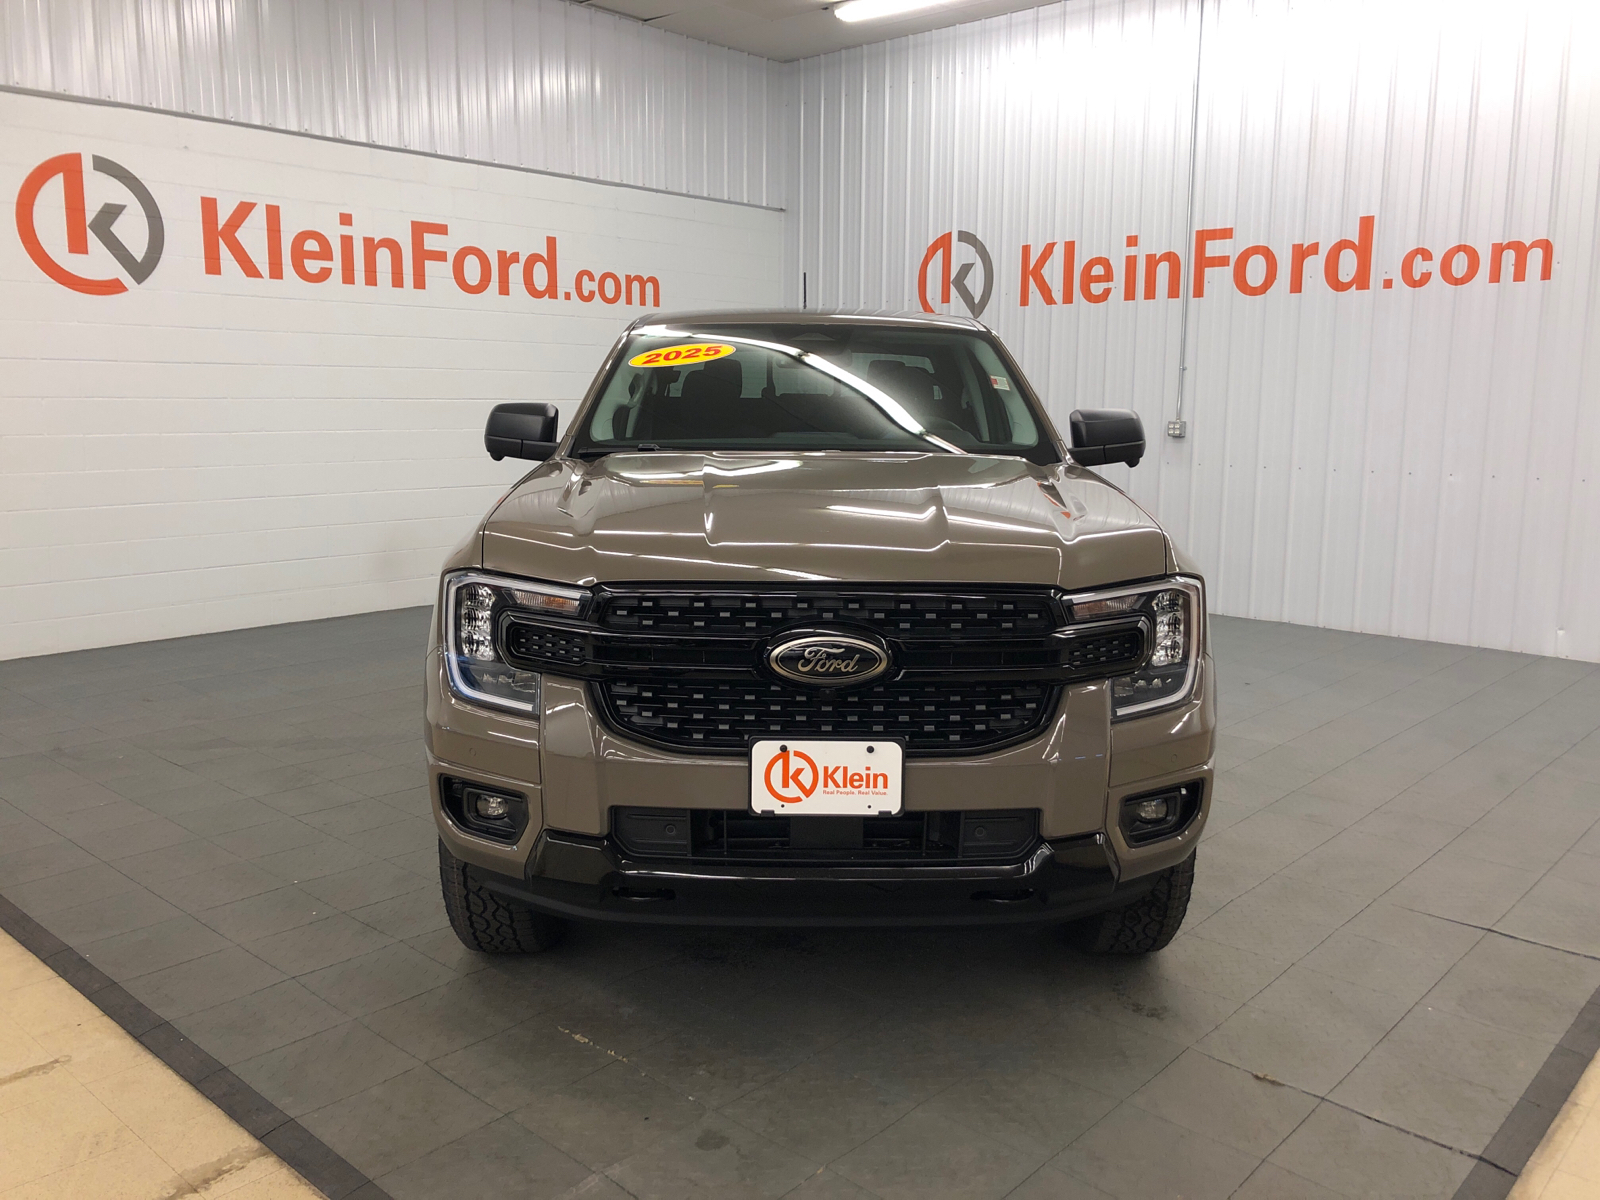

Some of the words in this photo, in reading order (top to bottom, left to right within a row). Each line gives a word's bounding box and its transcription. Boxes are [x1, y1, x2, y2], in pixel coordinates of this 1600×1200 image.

[200, 196, 661, 308] KleinFord.com
[1019, 215, 1554, 307] KleinFord.com
[642, 345, 722, 365] 2025
[797, 646, 860, 672] Ford
[823, 766, 889, 789] Klein
